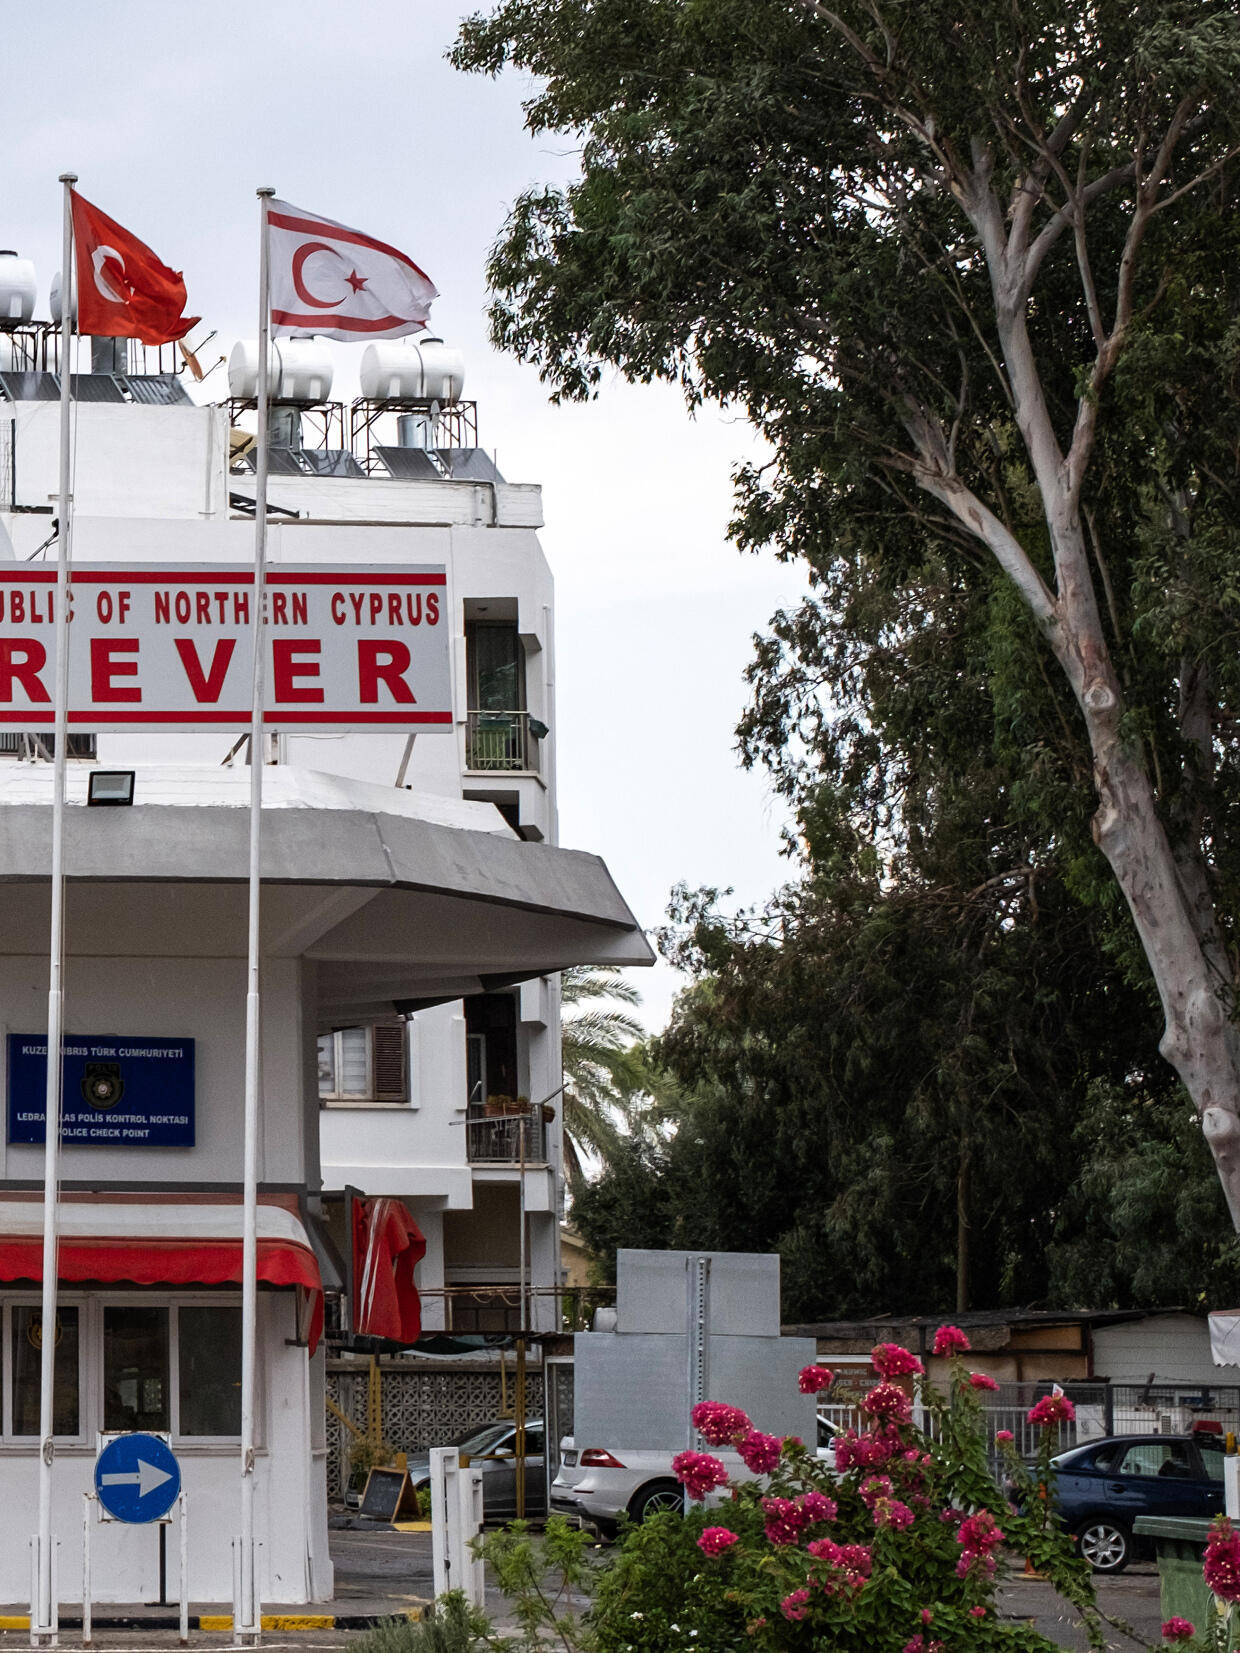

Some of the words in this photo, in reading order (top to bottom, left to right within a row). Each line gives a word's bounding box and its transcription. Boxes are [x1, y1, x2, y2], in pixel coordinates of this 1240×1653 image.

[96, 590, 131, 624] OF
[154, 591, 308, 625] NORTHRN
[331, 592, 440, 626] CYPRUS
[22, 1046, 48, 1055] KUZE
[59, 1046, 88, 1056] IBRIS
[17, 1112, 46, 1121] LEDRA
[105, 1114, 148, 1124] KONTROL
[149, 1115, 189, 1124] NOKTASI
[89, 1128, 121, 1137] CHECK
[122, 1129, 150, 1138] POINT
